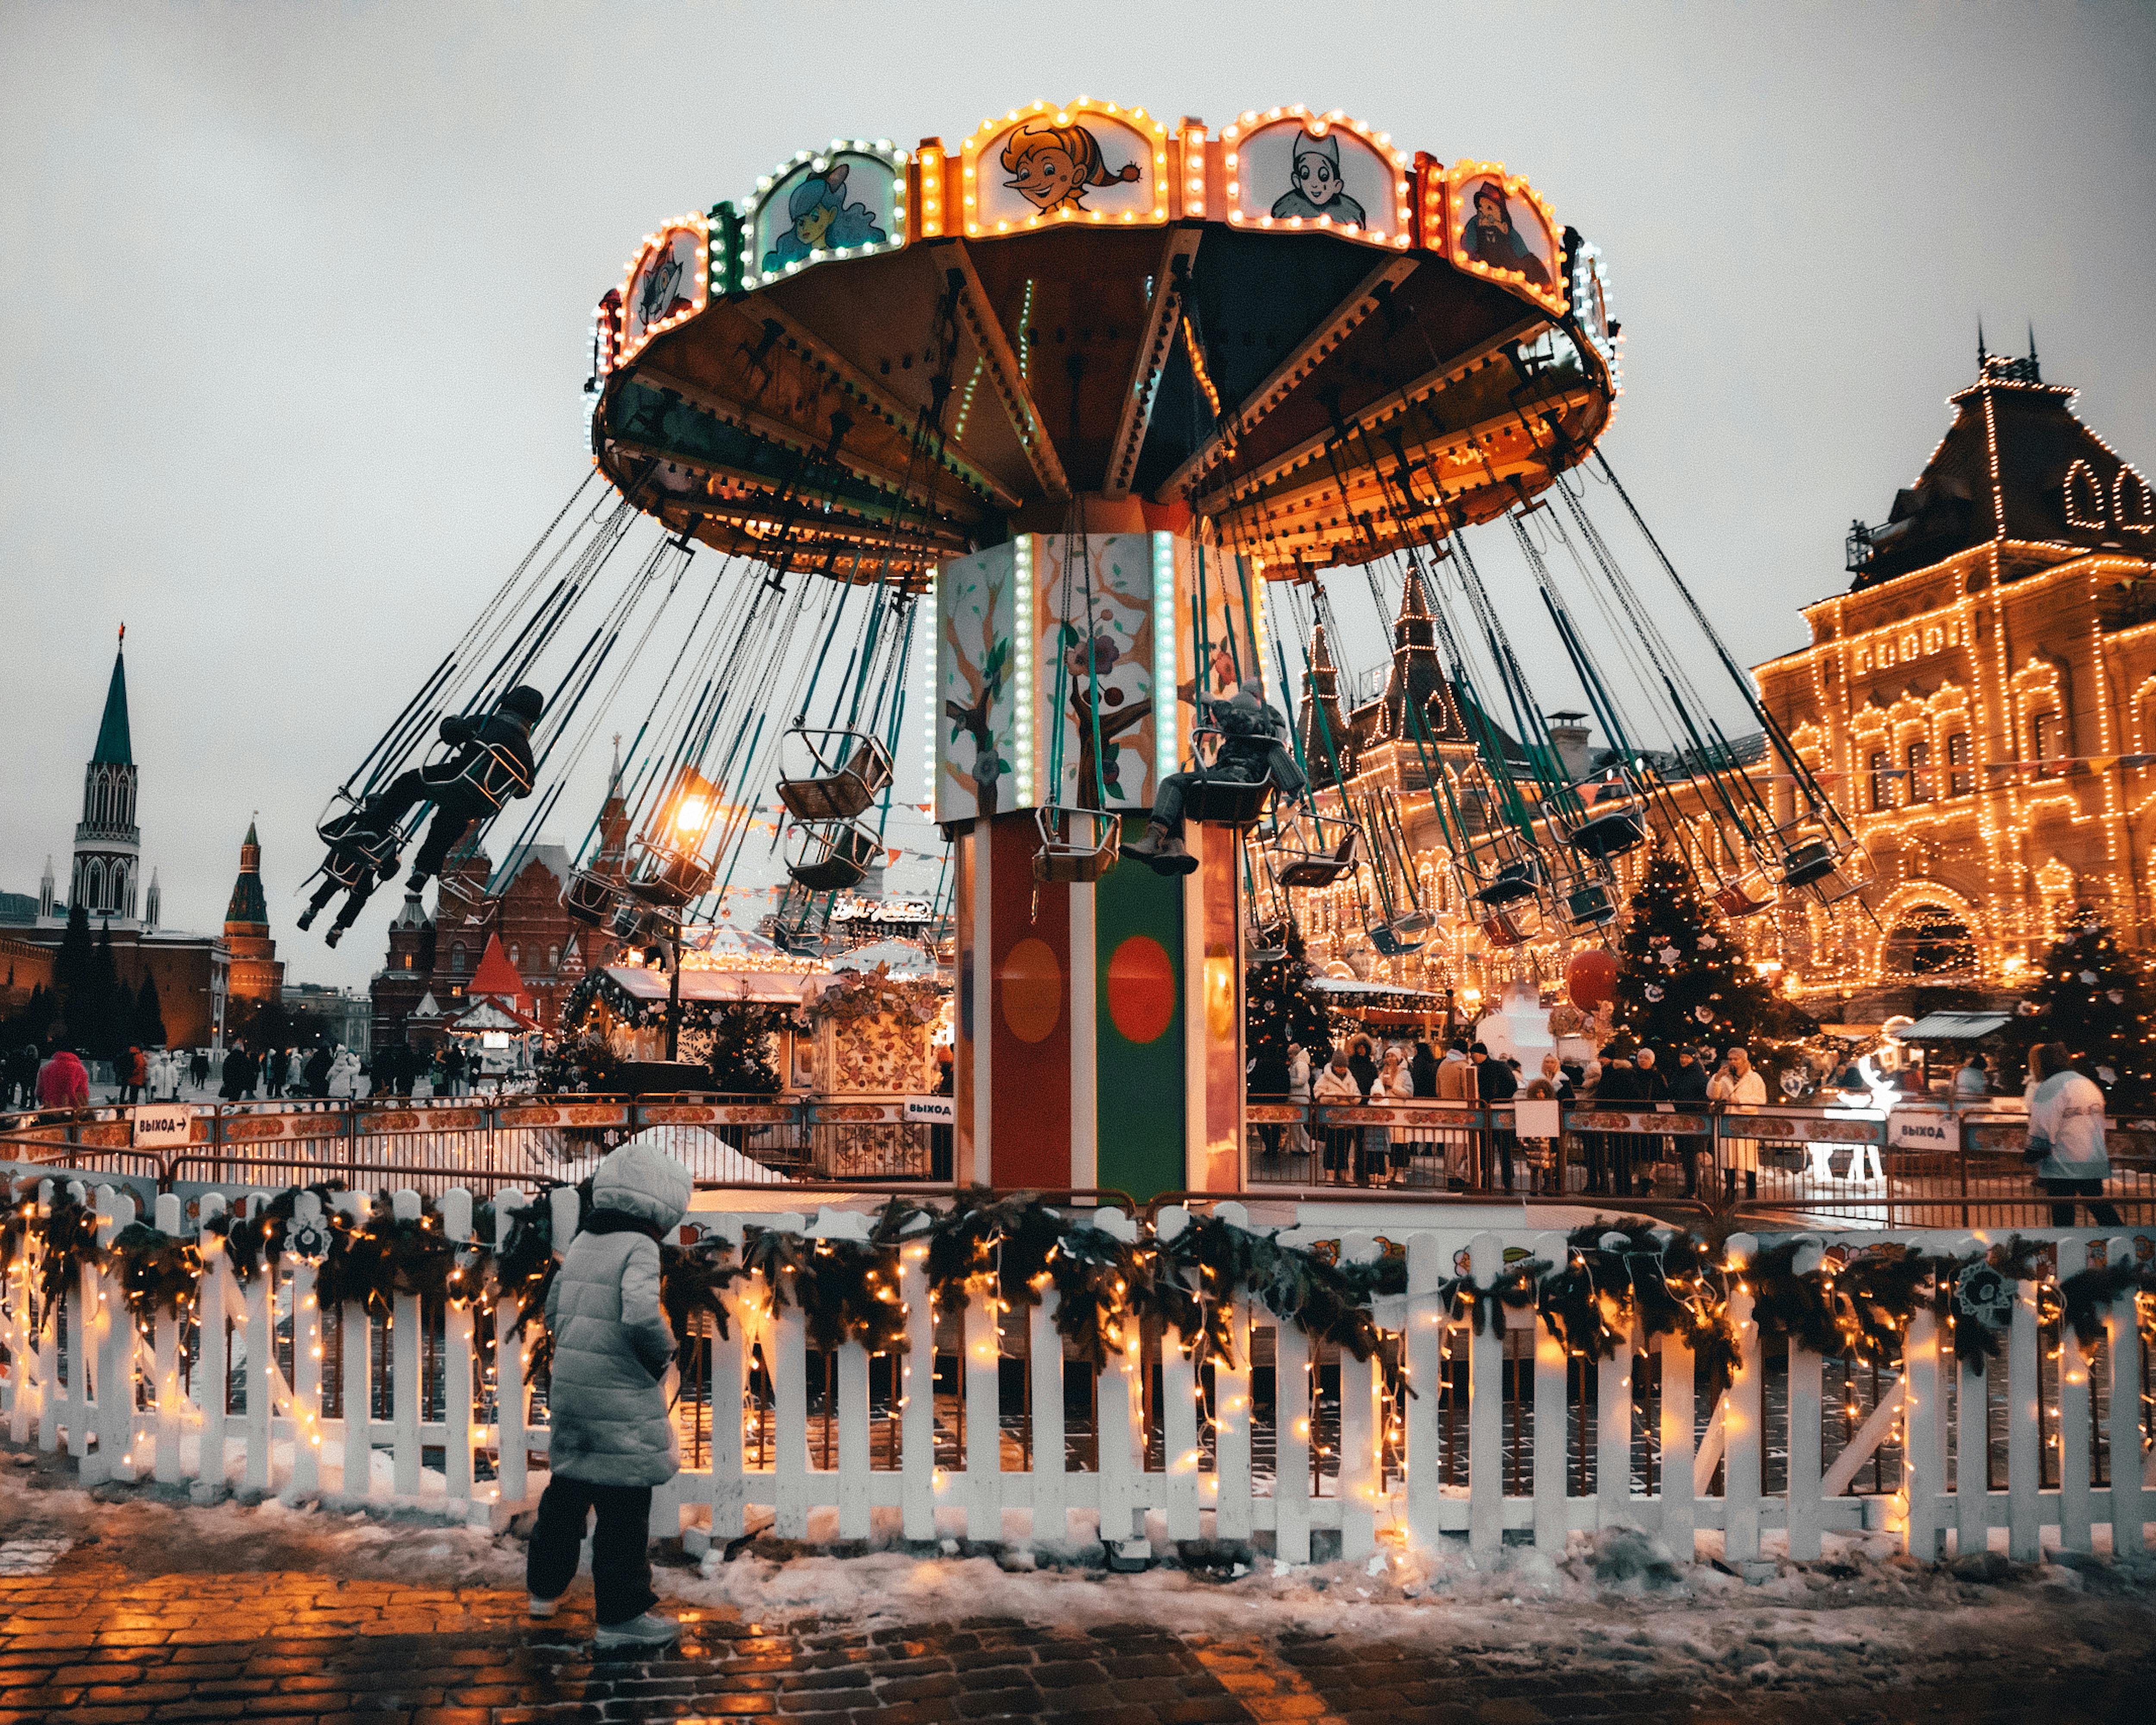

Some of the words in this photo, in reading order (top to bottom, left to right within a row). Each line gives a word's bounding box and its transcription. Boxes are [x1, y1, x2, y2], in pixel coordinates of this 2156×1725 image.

[910, 1104, 951, 1116] ВЫХОД
[140, 1119, 175, 1133] ВЫХОД
[1902, 1125, 1946, 1139] ВЫХОД
